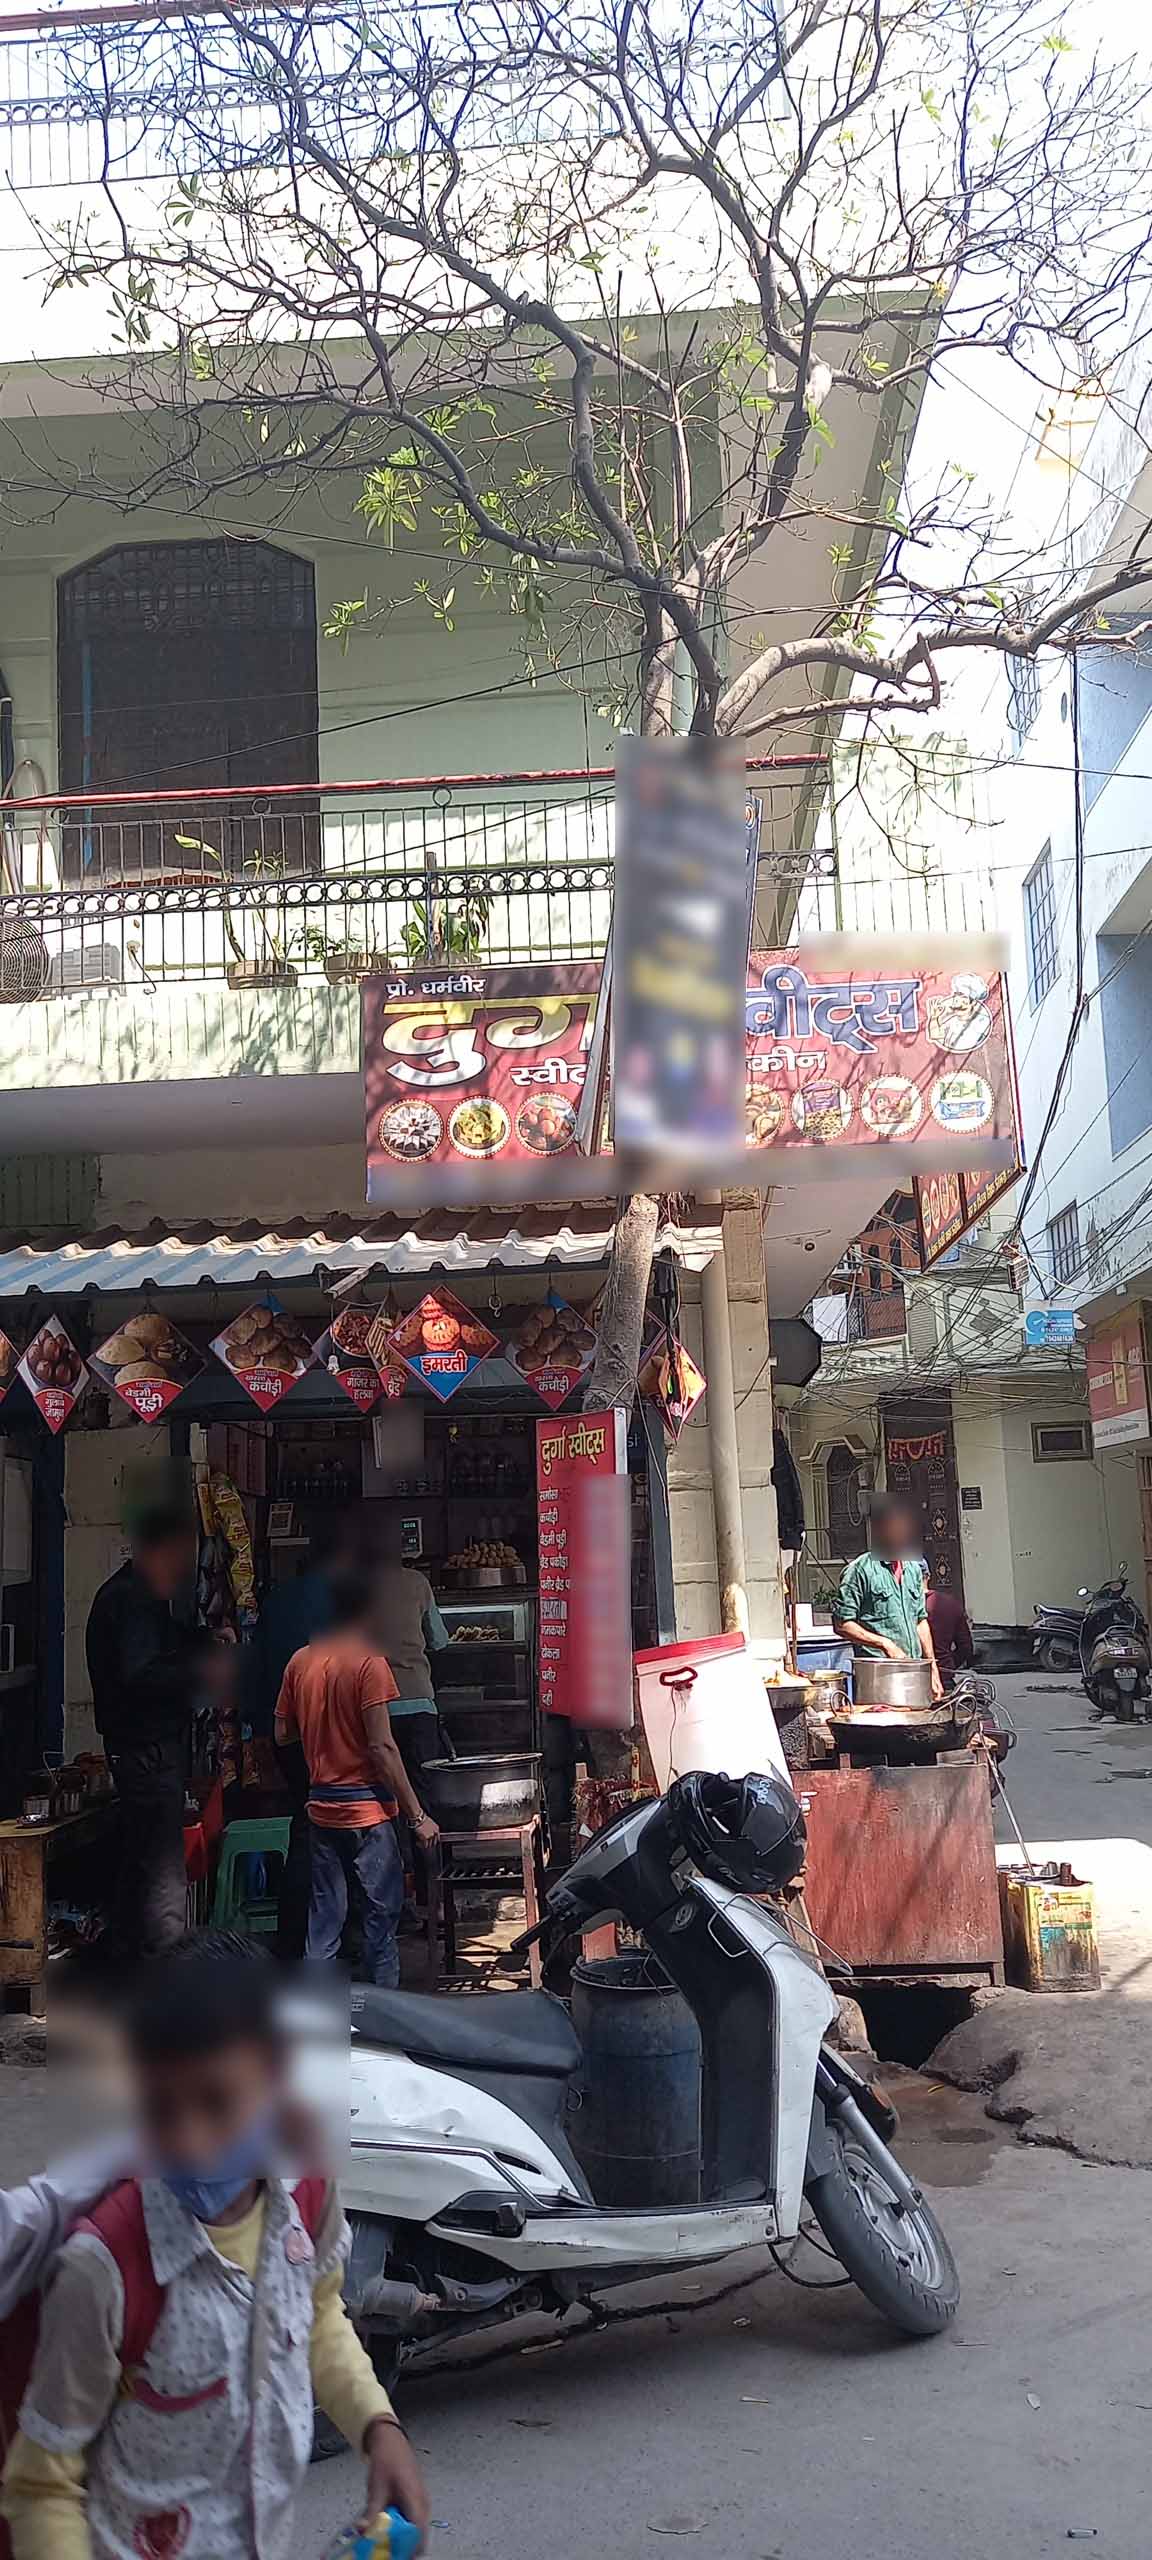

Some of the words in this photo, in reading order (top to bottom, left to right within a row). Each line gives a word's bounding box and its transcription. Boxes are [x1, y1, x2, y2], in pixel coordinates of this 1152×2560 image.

[386, 980, 414, 999] प्रो.
[421, 974, 486, 996] धर्मवीर
[421, 1350, 467, 1376] इमरती
[541, 1425, 567, 1475] दुर्गा
[568, 1422, 605, 1464] स्वीट्स
